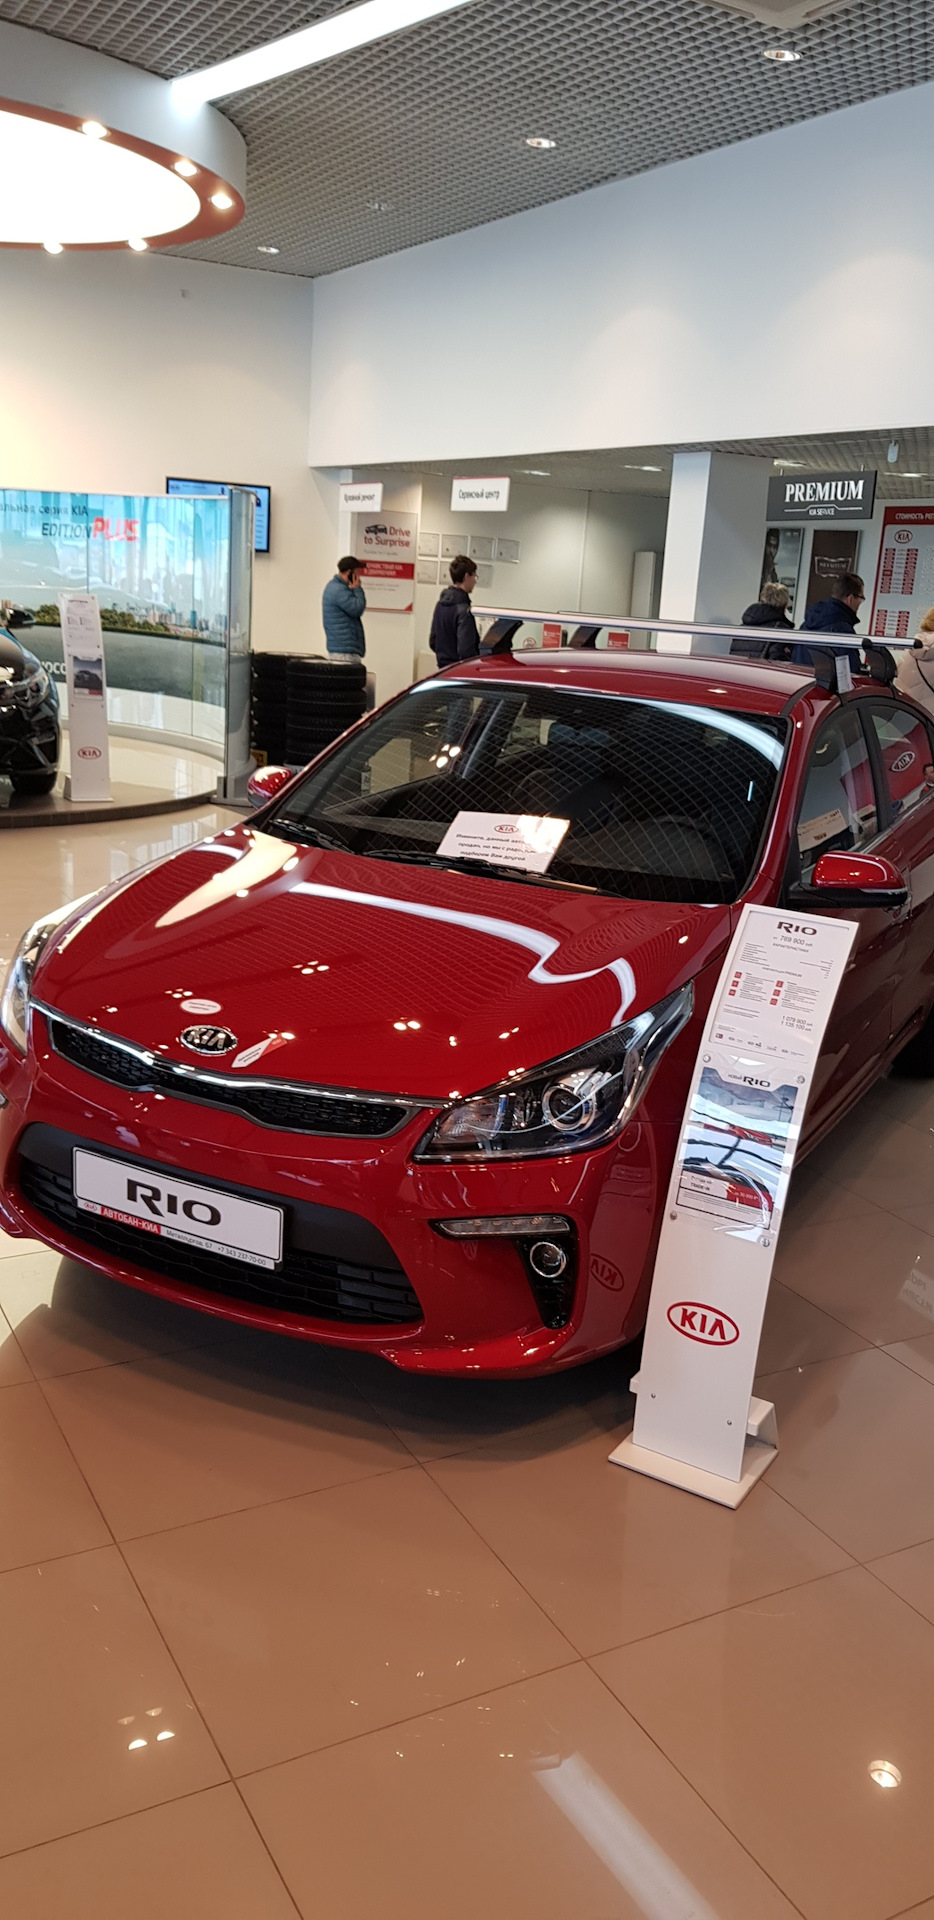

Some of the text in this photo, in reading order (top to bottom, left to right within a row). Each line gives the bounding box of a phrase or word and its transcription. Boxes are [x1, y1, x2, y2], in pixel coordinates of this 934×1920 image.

[458, 489, 500, 500] Сервисный центр
[784, 479, 865, 503] PREMIUM
[38, 504, 69, 516] серия
[71, 504, 89, 516] KIA
[92, 516, 139, 542] PLUS
[389, 526, 411, 537] Drive
[364, 536, 411, 548] to Surprise
[776, 921, 818, 936] RIO
[186, 1027, 226, 1049] KIA
[743, 1075, 771, 1088] RIO
[126, 1178, 222, 1226] RIO
[103, 1207, 159, 1233] АВТОБАН-КИА
[204, 1241, 213, 1249] 67
[225, 1248, 237, 1257] 343
[680, 1307, 726, 1341] KIA
